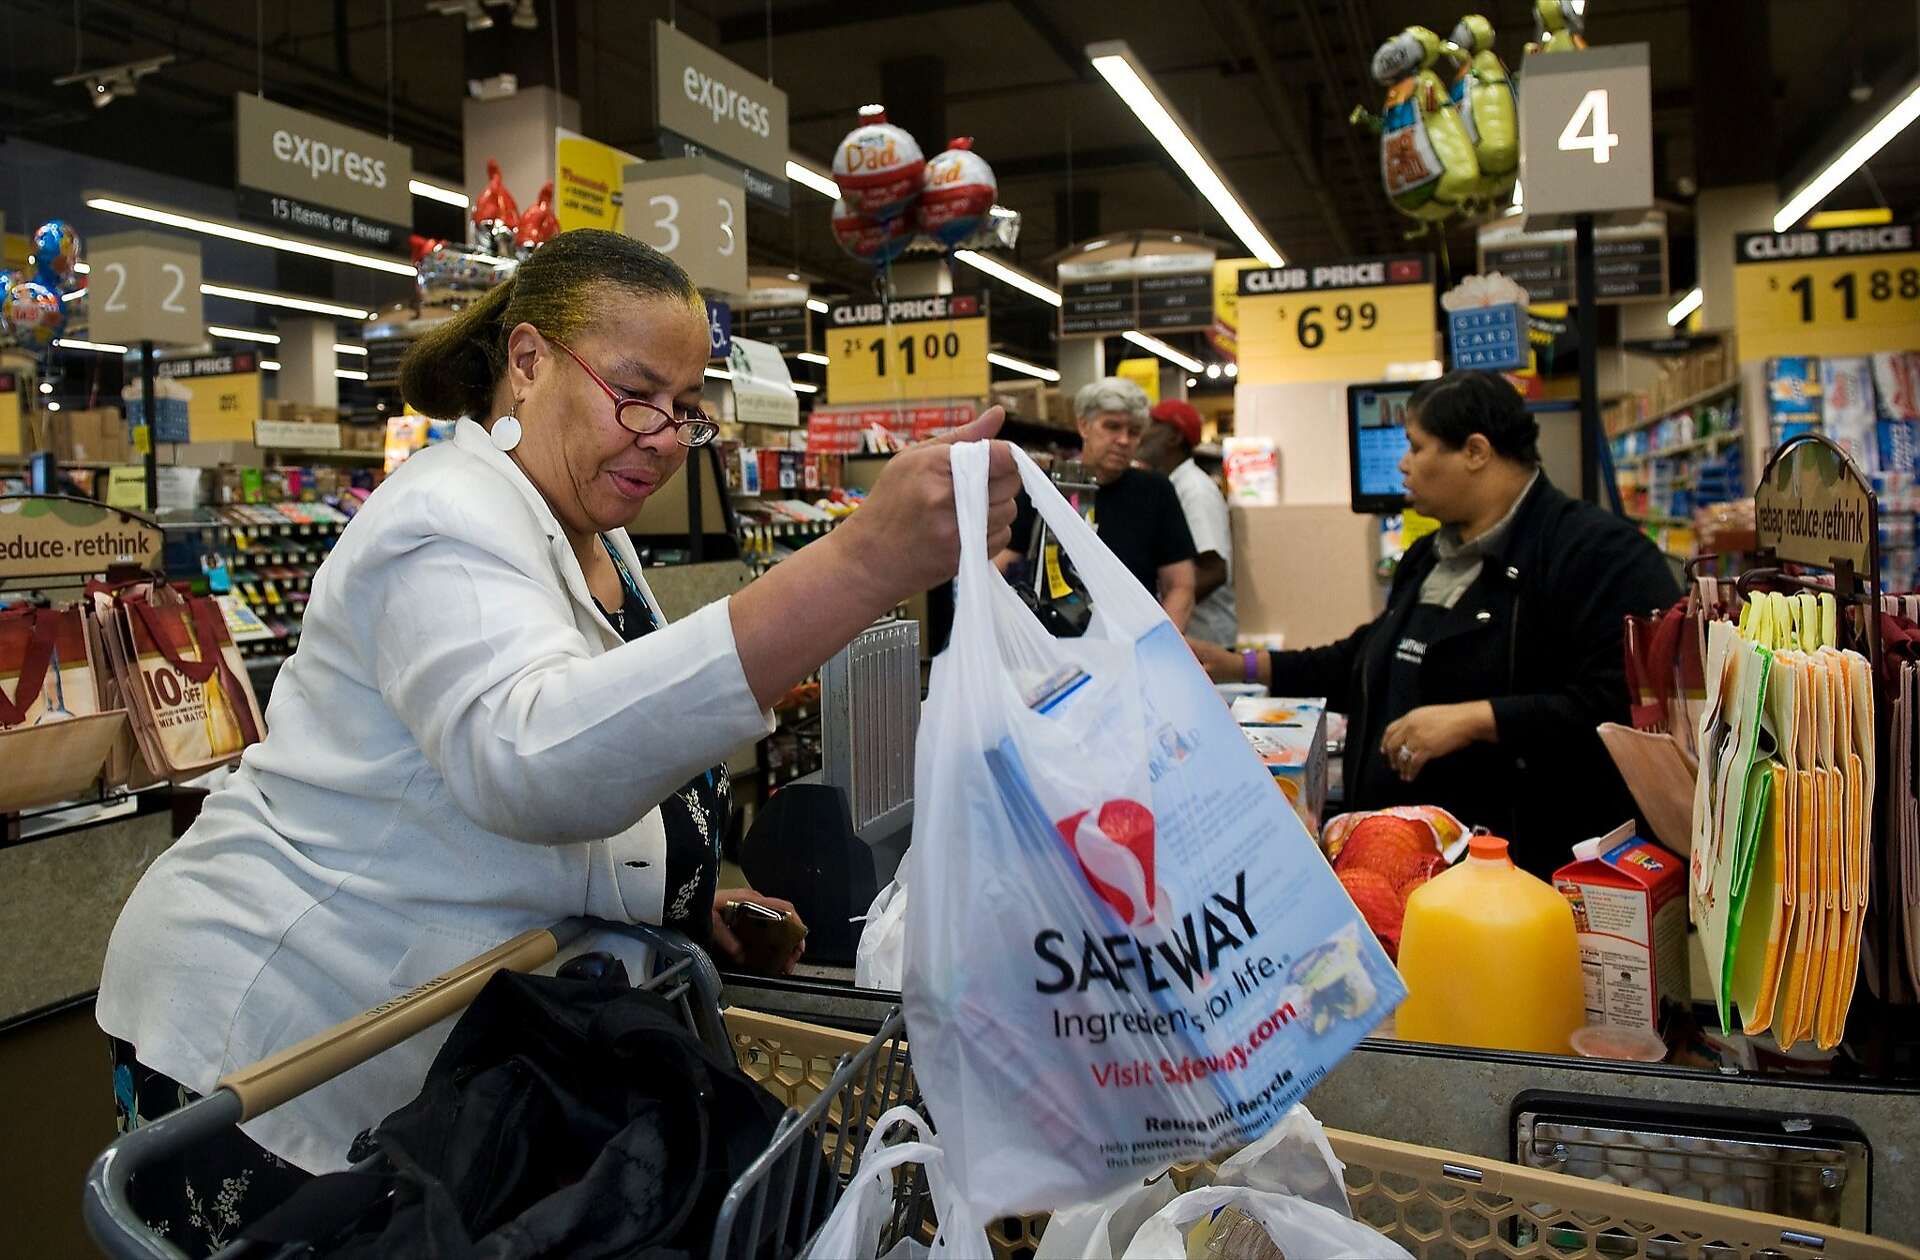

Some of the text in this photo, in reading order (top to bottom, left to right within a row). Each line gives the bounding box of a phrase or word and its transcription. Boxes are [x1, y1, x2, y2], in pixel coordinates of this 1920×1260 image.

[683, 66, 770, 138] express
[1558, 89, 1619, 164] 4
[272, 130, 388, 189] express
[846, 138, 896, 173] Dad
[271, 198, 390, 243] 15 items or fewer
[650, 195, 680, 254] 3
[717, 198, 735, 256] 3
[1746, 225, 1911, 259] CLUB PRICE
[104, 263, 128, 312] 2
[161, 263, 186, 313] 2
[1246, 268, 1308, 291] CLUB
[1313, 262, 1385, 287] PRICE
[833, 299, 947, 325] CLUB PRICE
[194, 357, 233, 374] PRICE
[183, 687, 200, 703] OFF
[159, 717, 174, 728] MIX
[1034, 870, 1258, 994] SAFEWAY
[1053, 1007, 1207, 1044] Ingredens
[1091, 1001, 1297, 1088] Visit Sfeway.com
[1145, 1069, 1294, 1133] Reuse and Recycle
